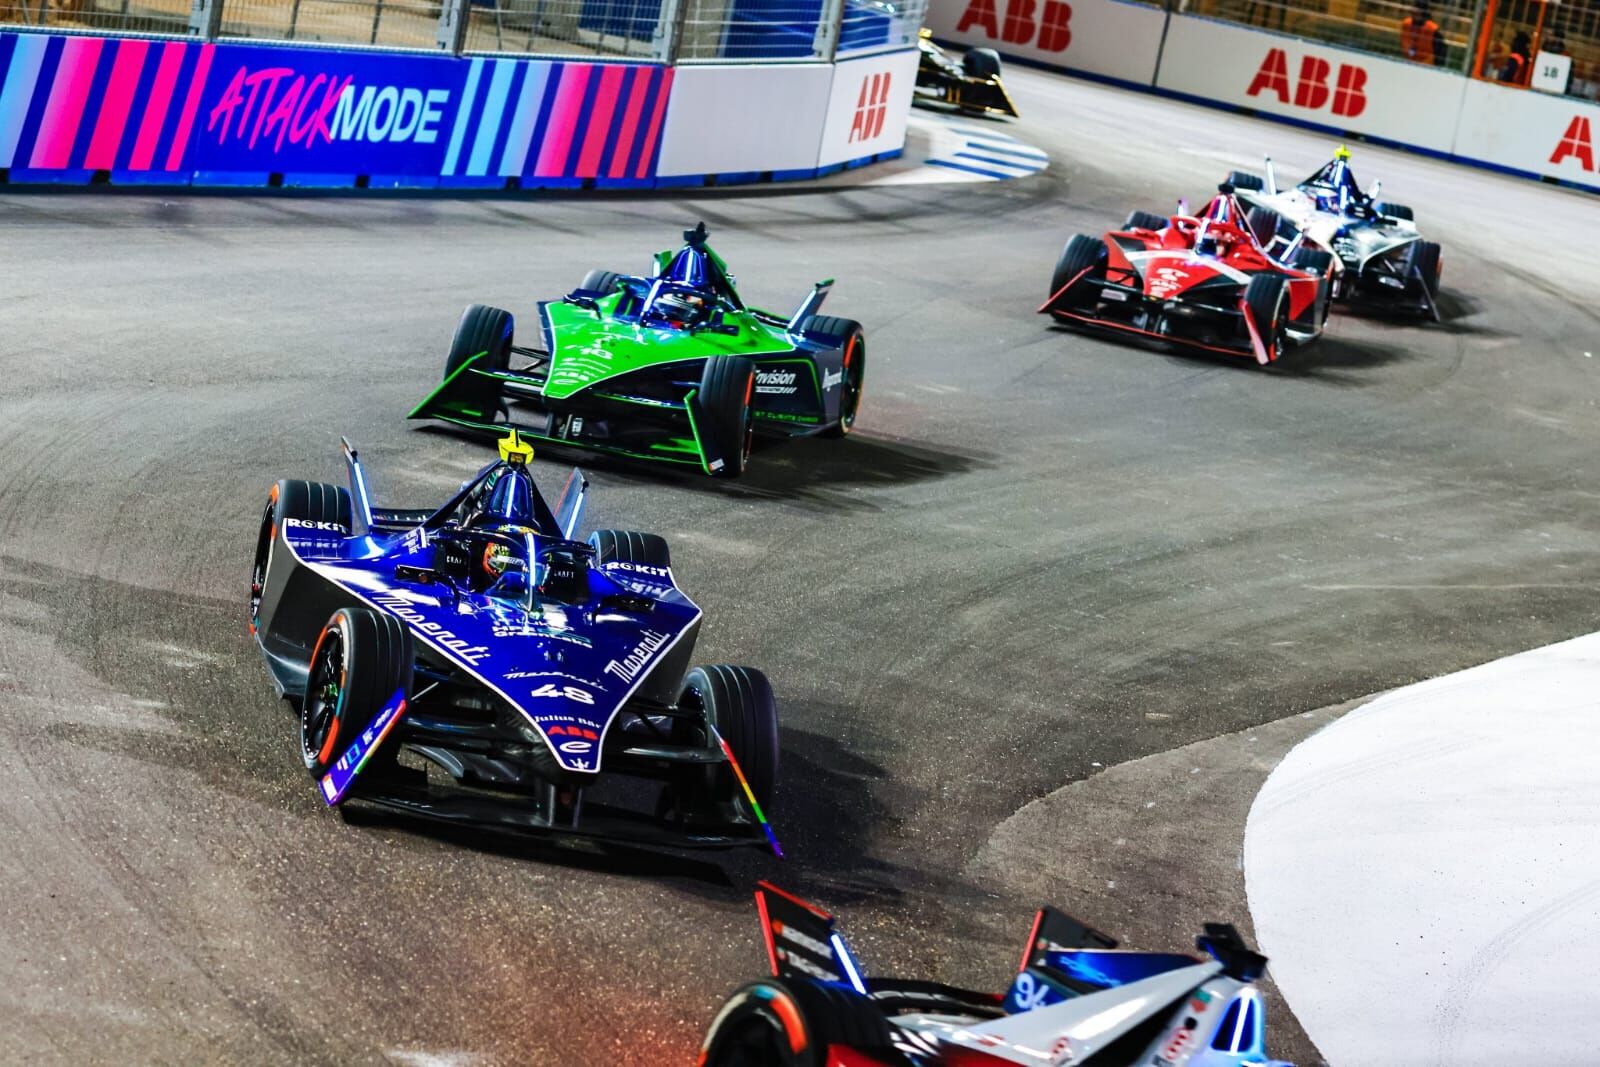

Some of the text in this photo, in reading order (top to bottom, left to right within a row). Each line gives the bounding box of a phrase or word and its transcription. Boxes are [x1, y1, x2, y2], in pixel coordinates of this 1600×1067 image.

[956, 0, 1073, 53] ABB
[207, 65, 450, 154] ATTACK MODE
[848, 71, 891, 144] ABB
[1246, 47, 1369, 118] ABB
[1549, 115, 1600, 173] A
[368, 591, 492, 667] Maserati
[603, 628, 671, 685] Maserati
[531, 683, 595, 705] 48
[547, 724, 598, 741] ABB
